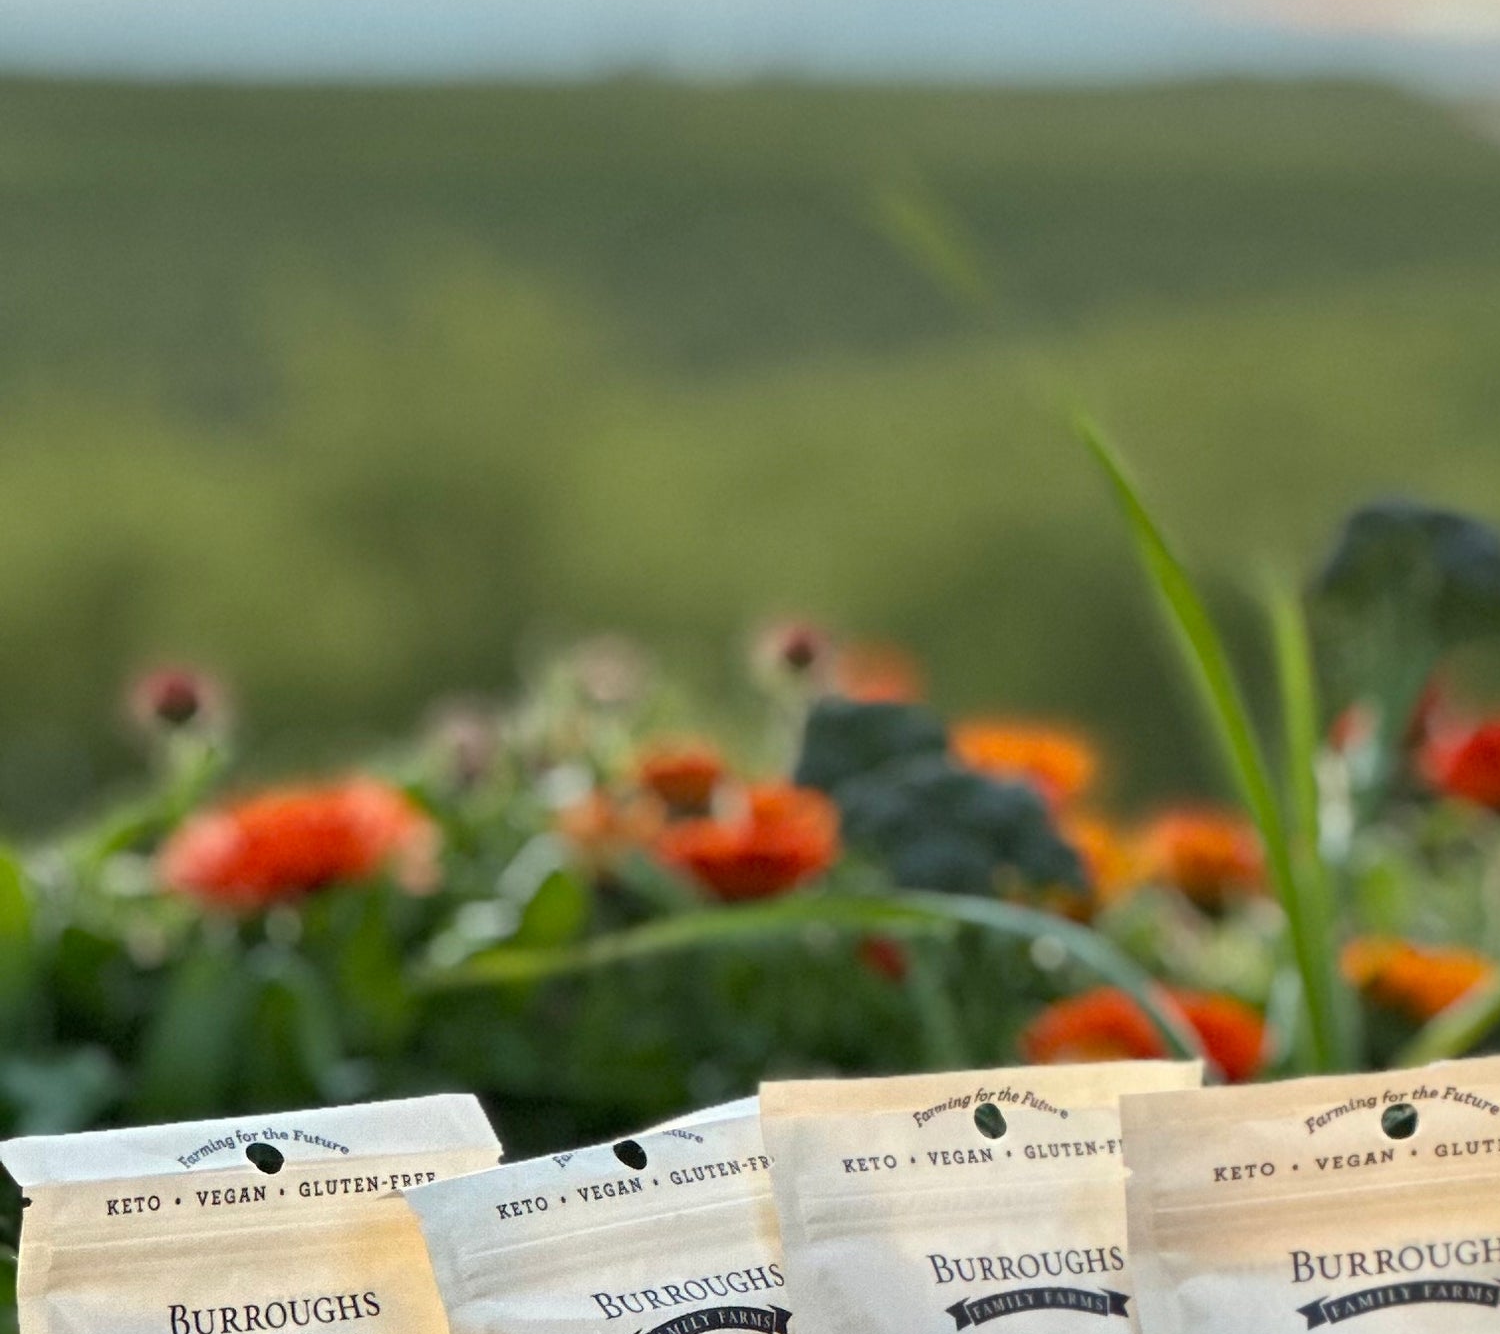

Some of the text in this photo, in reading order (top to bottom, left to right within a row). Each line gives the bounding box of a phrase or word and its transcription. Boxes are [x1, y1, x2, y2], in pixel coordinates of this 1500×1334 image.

[913, 1086, 1020, 1128] Farming for the
[1304, 1085, 1500, 1134] Farming for the Future
[178, 1127, 349, 1169] Farming for the Future
[842, 1148, 993, 1173] KETO VEGAN
[1213, 1162, 1275, 1183] KETO
[1316, 1148, 1395, 1171] VEGAN
[107, 1195, 160, 1215] KETO
[196, 1185, 266, 1207] VEGAN
[496, 1177, 643, 1220] KETO VEGAN
[926, 1246, 1124, 1284] BURROUGHS
[591, 1264, 784, 1319] BURROUGHS
[973, 1291, 1103, 1318] FAMILY FARMS
[1331, 1284, 1494, 1317] FAMILY FARMS
[720, 1311, 770, 1329] FARMS
